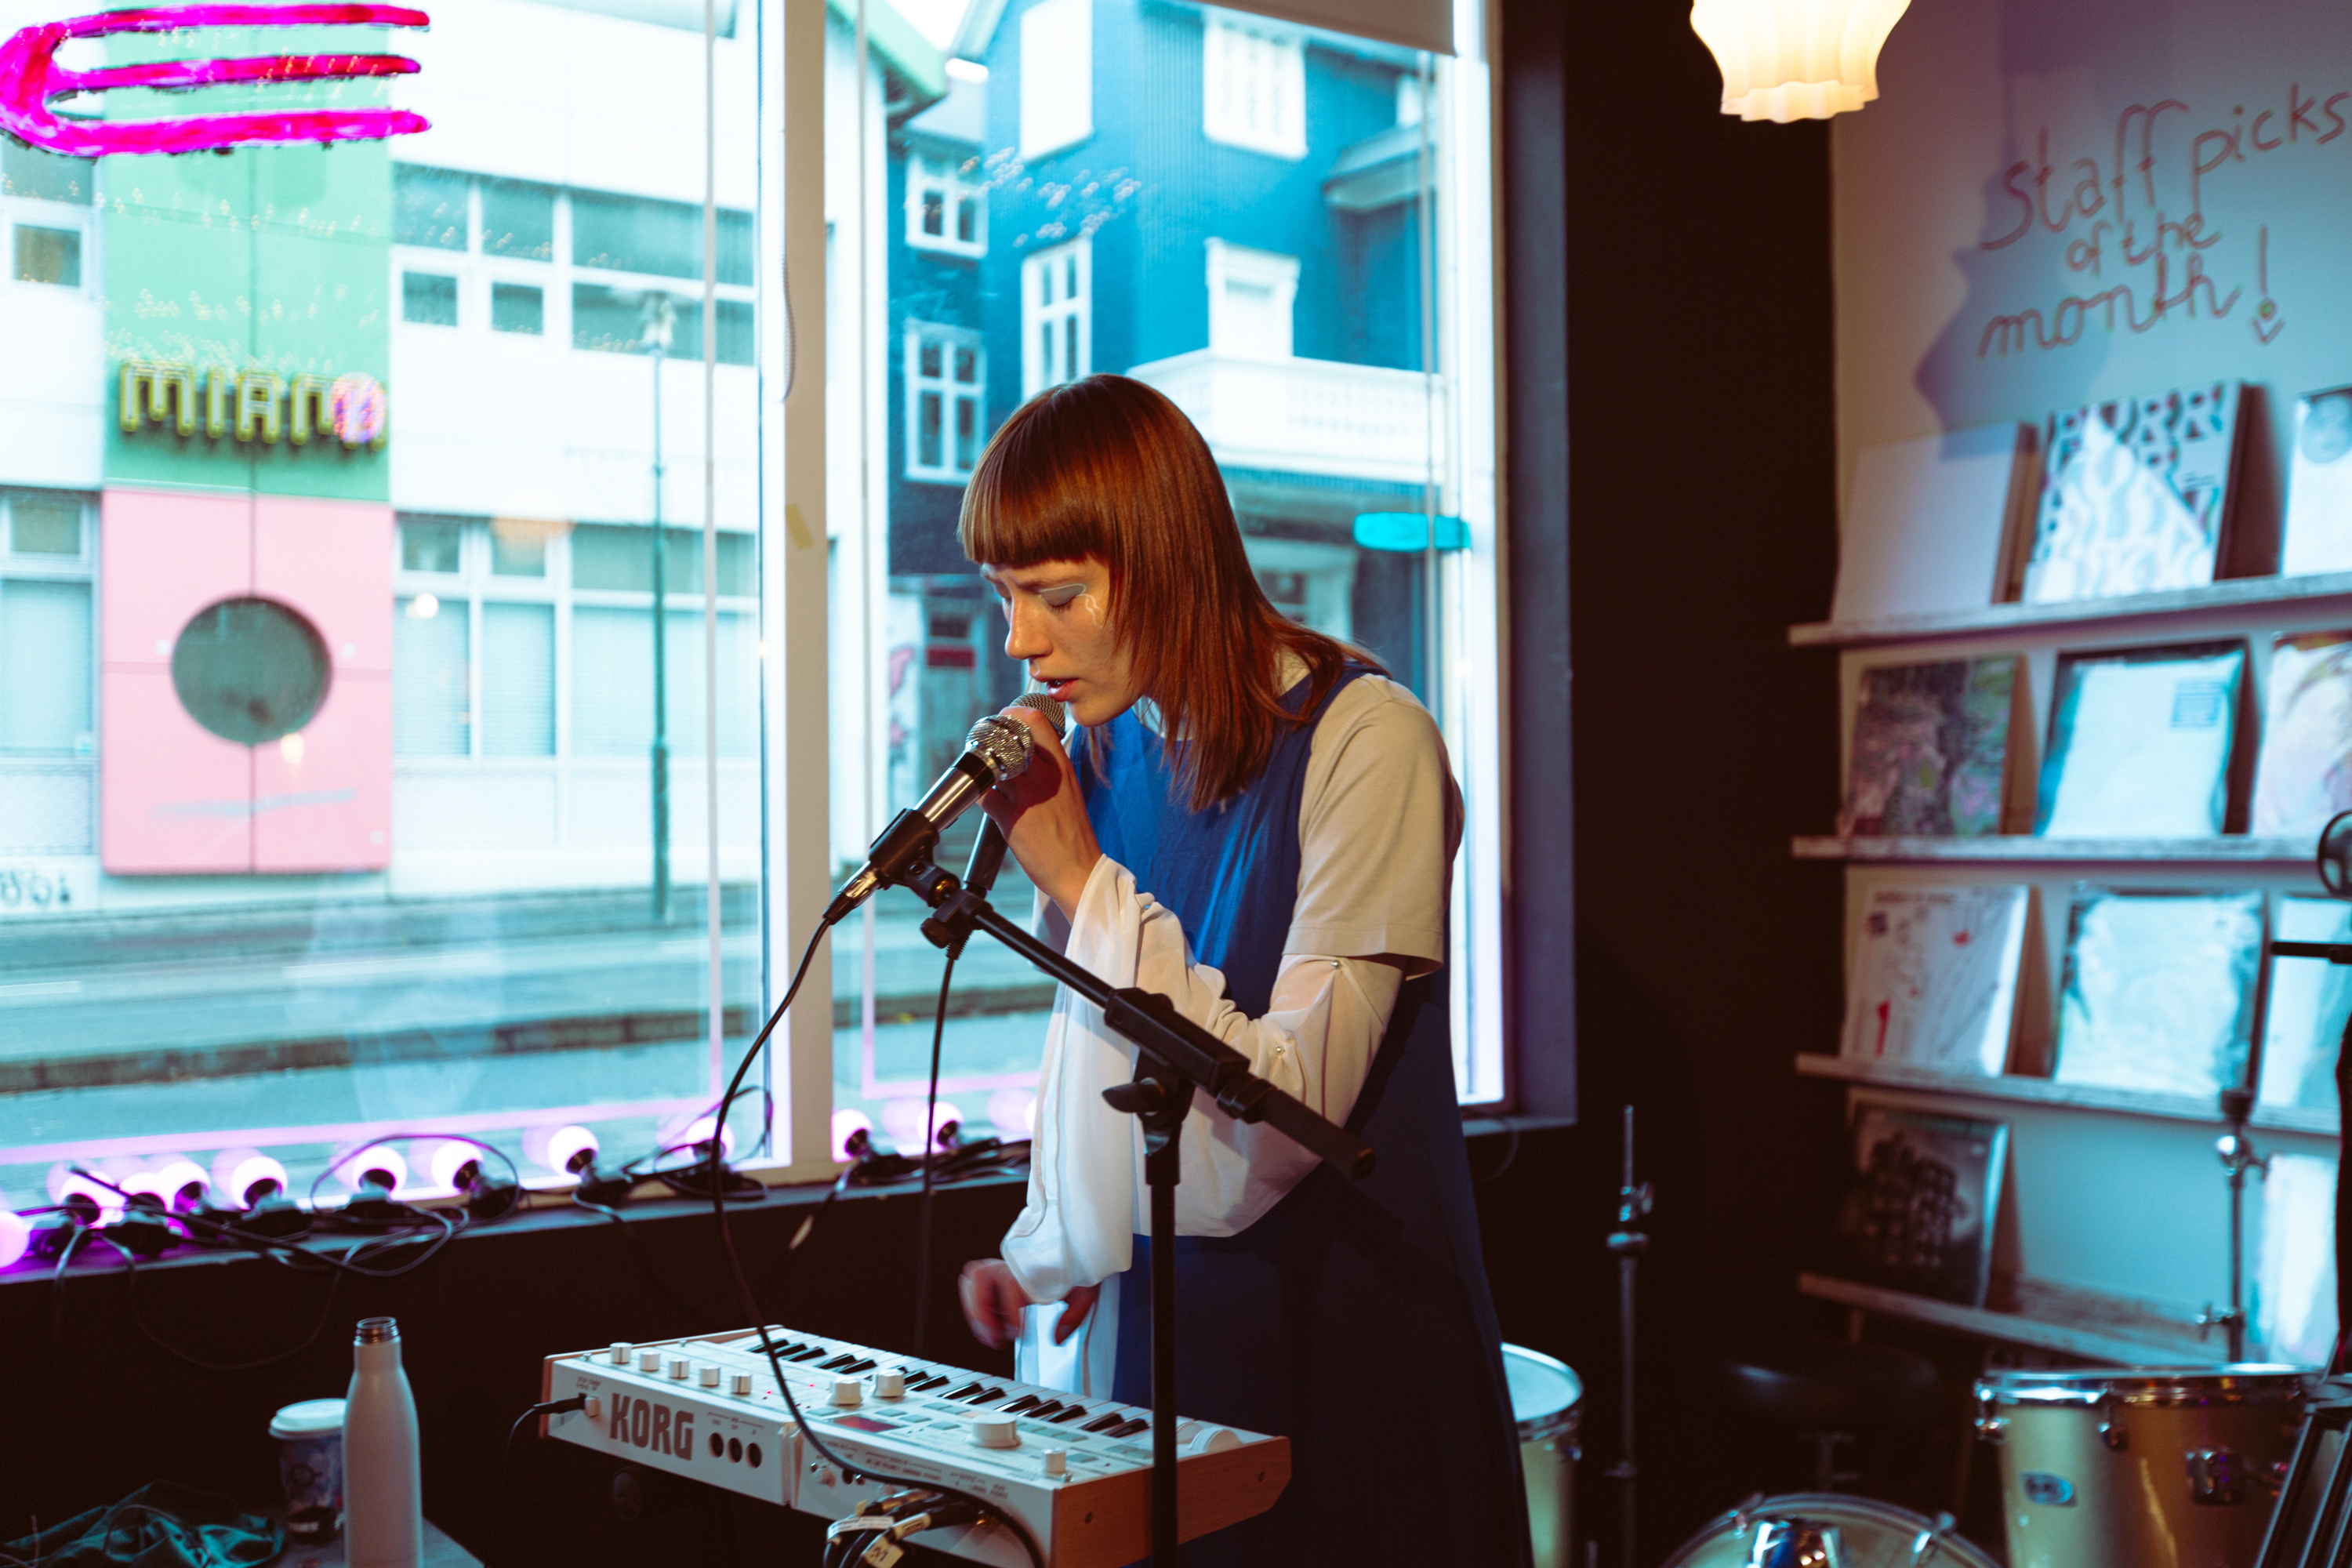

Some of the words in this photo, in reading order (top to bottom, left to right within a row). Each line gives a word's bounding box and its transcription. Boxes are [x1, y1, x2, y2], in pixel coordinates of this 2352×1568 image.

[1979, 100, 2190, 251] Staff
[2192, 82, 2351, 213] picks
[2065, 220, 2114, 278] of
[2122, 210, 2223, 266] the
[119, 360, 387, 452] MIAM
[610, 1392, 694, 1461] KORG
